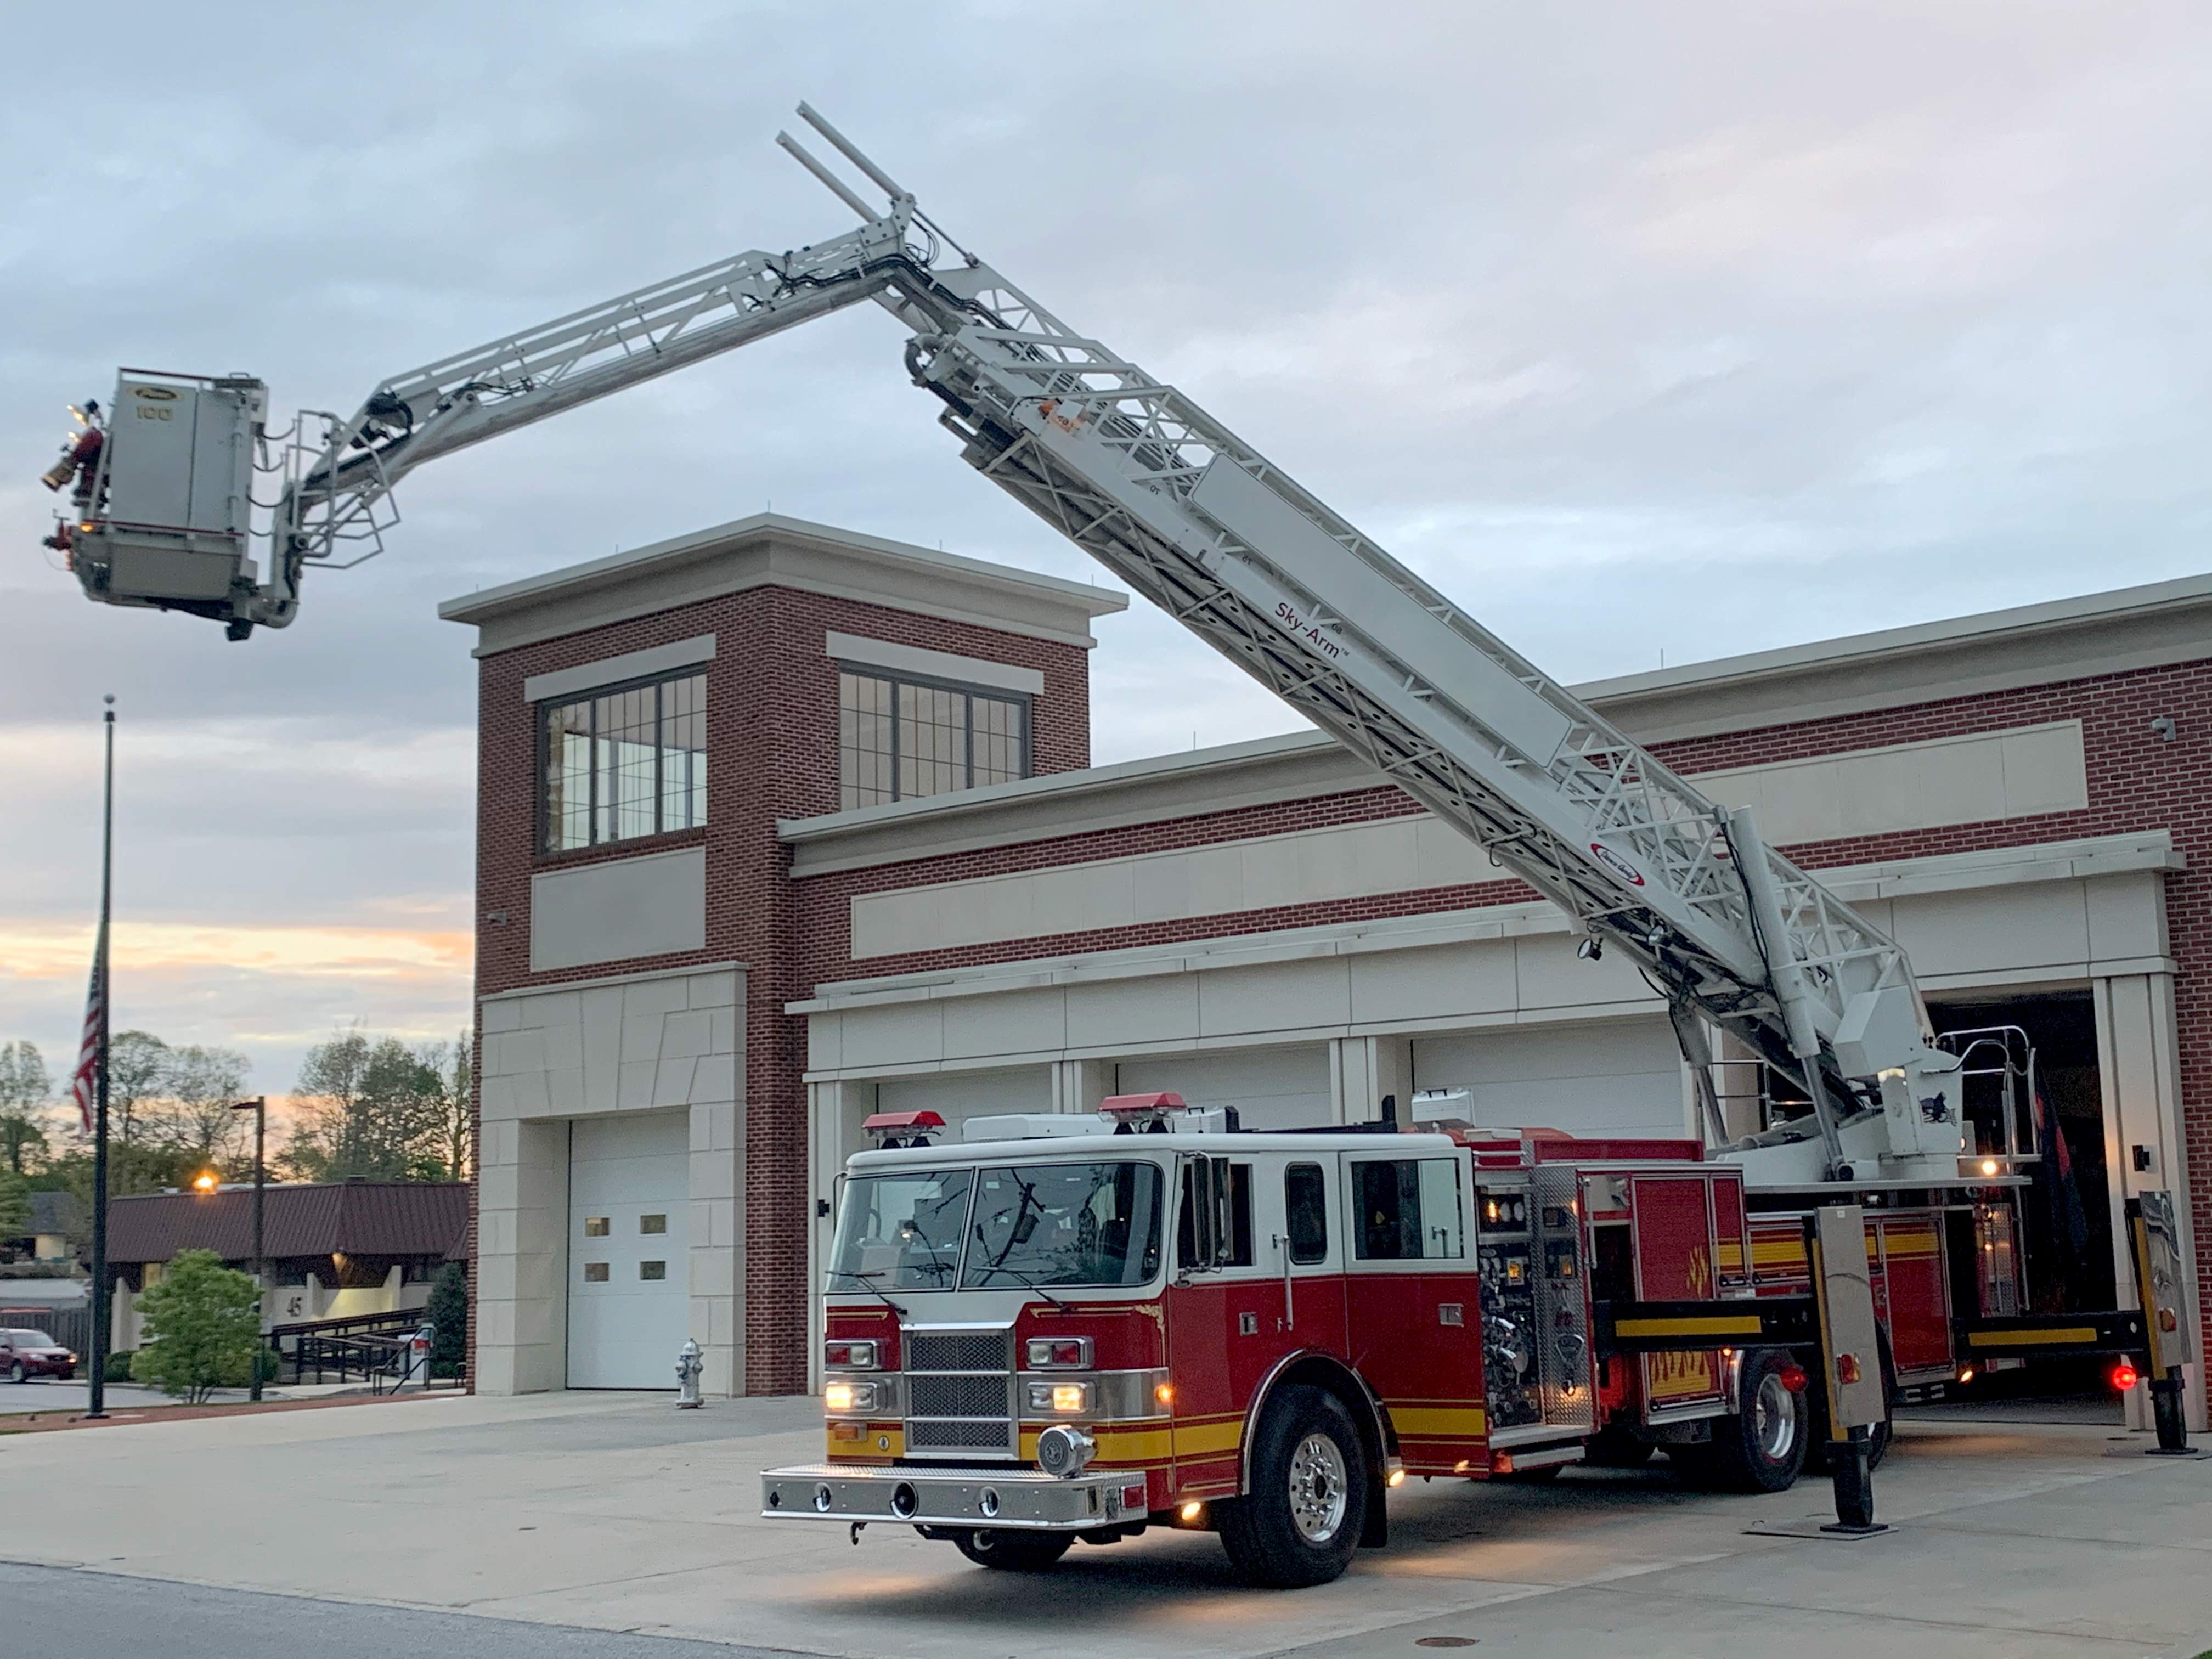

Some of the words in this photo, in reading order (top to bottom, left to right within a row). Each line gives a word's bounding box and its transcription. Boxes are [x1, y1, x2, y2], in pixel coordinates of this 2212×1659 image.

[136, 404, 173, 421] 100
[1274, 602, 1339, 658] Sky-Arm
[287, 1296, 301, 1318] 45
